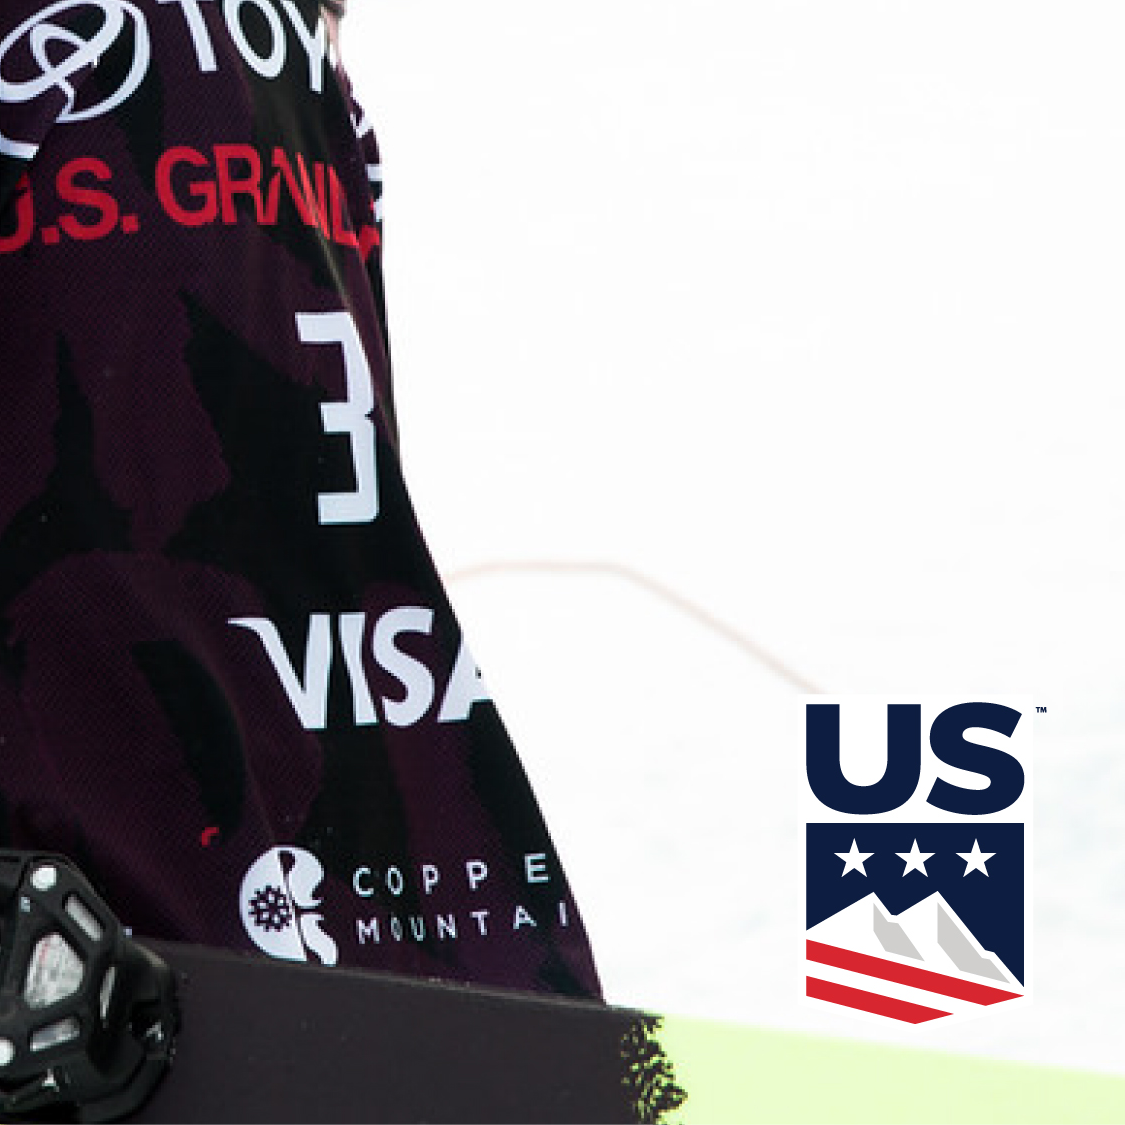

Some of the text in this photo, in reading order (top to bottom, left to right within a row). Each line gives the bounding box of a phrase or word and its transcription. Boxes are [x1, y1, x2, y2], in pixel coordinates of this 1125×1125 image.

[295, 312, 380, 525] 3
[352, 852, 552, 898] COPPE
[356, 900, 569, 945] MOUNTAI
